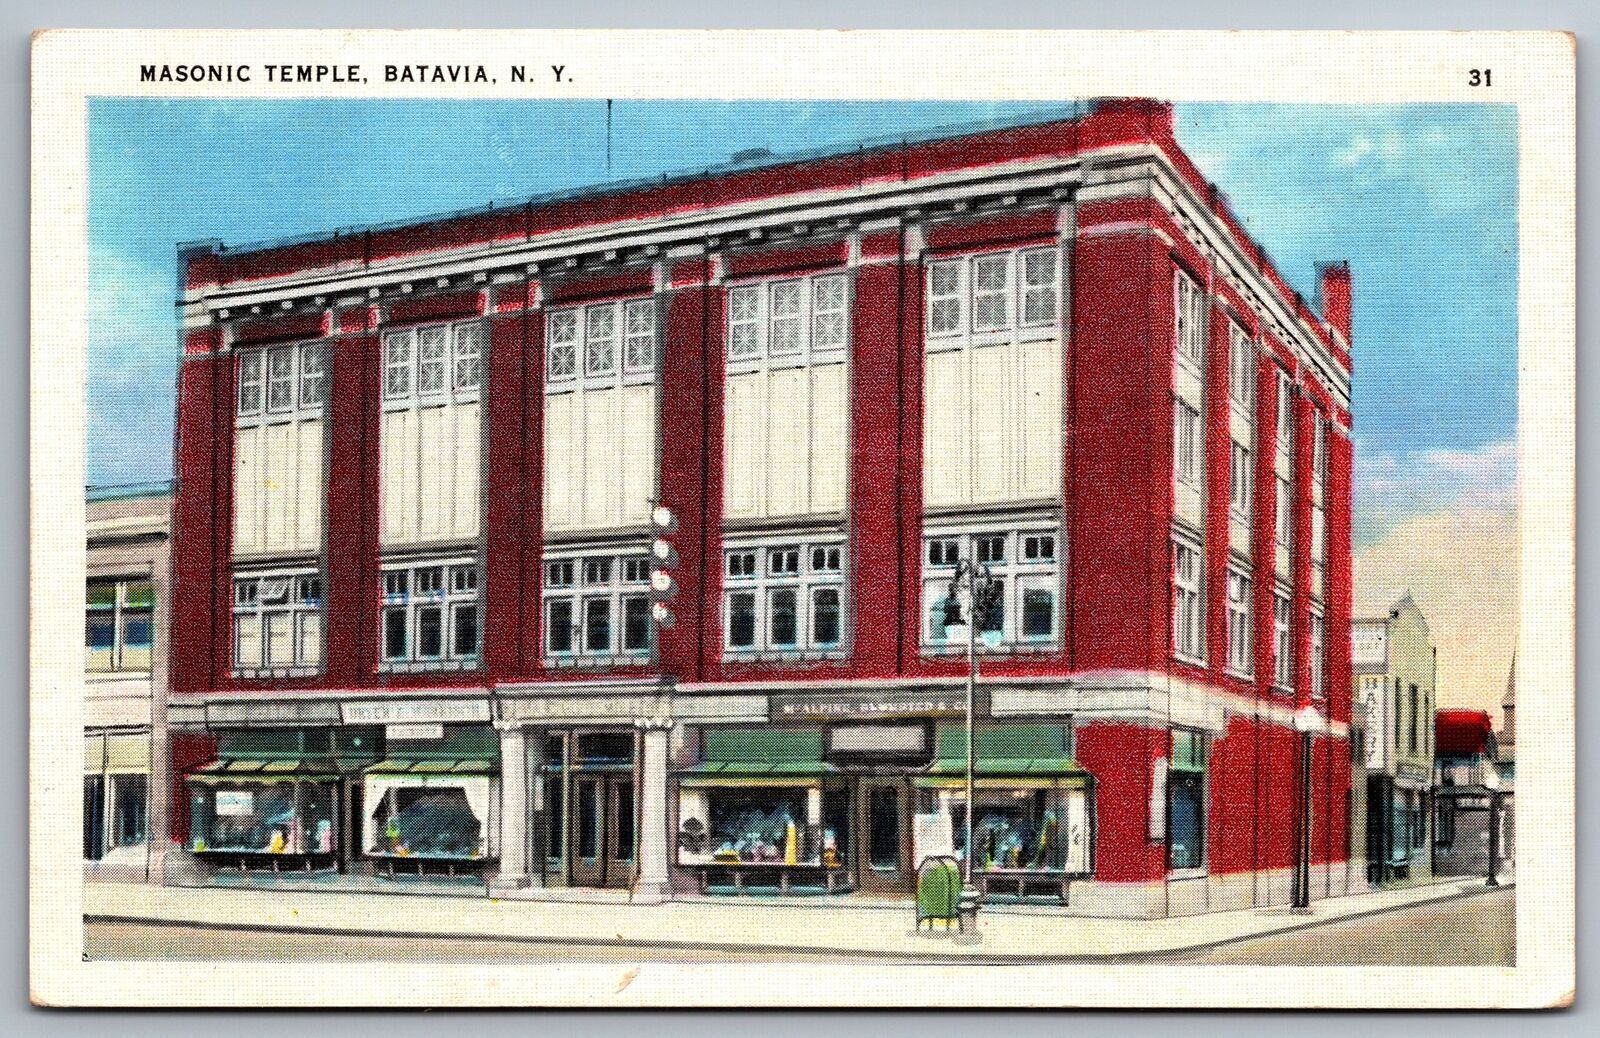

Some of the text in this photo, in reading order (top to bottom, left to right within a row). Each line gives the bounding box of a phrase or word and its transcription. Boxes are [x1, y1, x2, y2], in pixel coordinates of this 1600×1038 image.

[141, 65, 572, 83] MASONIC TEMPLE, BATAVIA, N. Y.
[1469, 69, 1491, 86] 31
